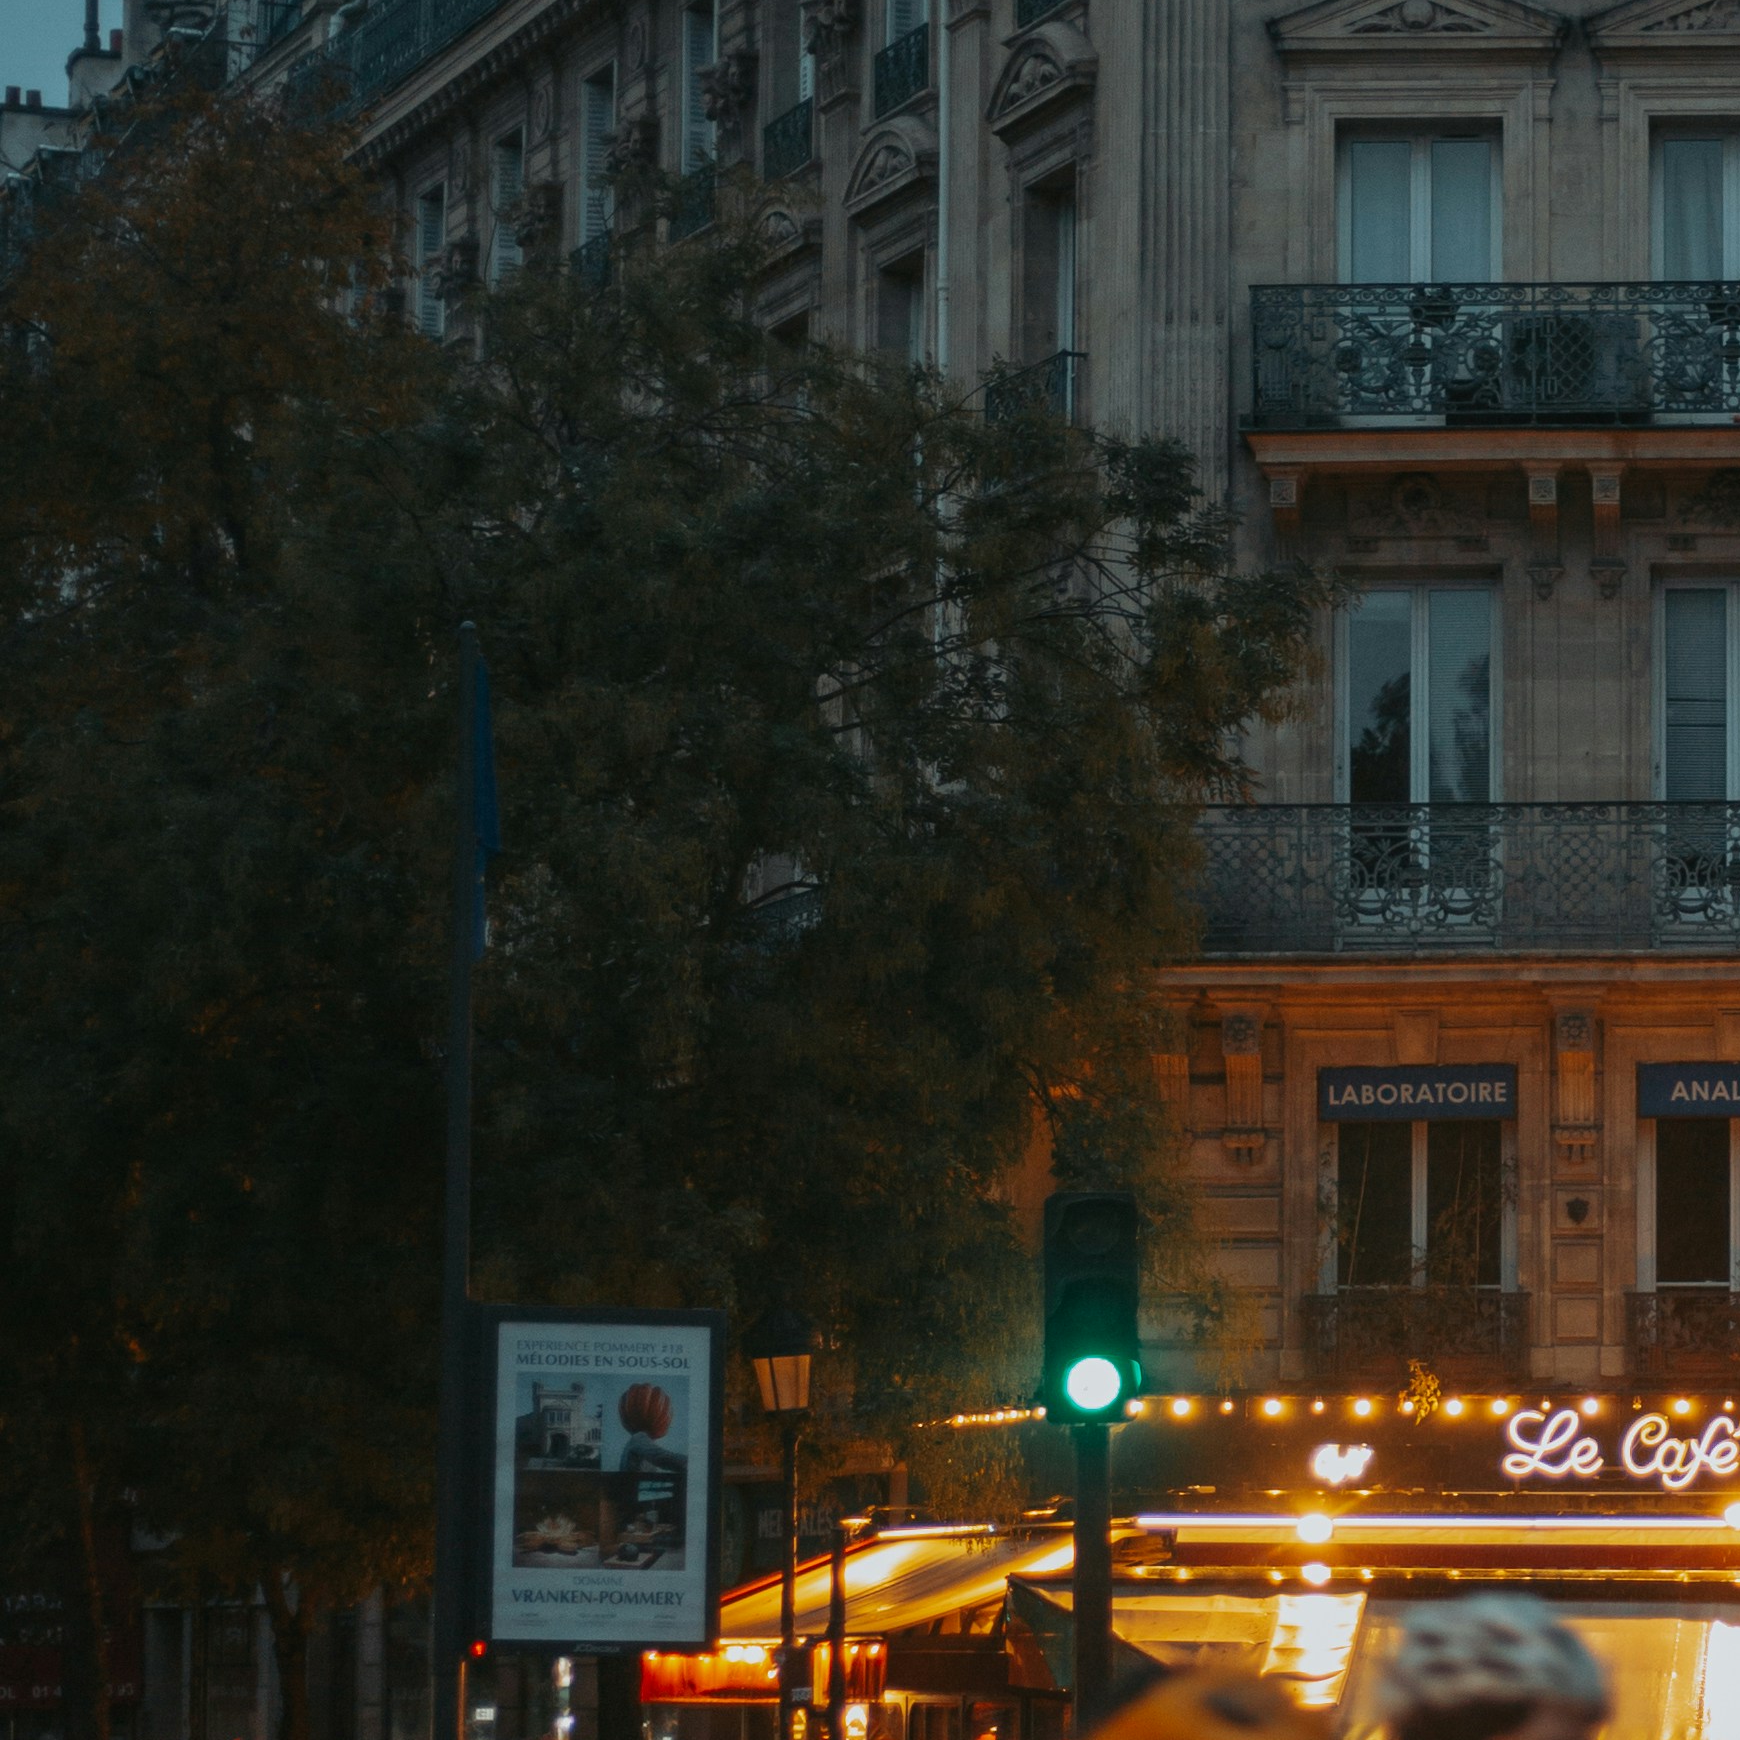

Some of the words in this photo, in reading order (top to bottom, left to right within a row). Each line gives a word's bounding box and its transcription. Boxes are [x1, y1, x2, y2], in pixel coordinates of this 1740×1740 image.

[1328, 1081, 1507, 1106] LABORATOIRE
[594, 1341, 655, 1354] POMMERY
[516, 1352, 590, 1366] MÉLODIES
[594, 1355, 613, 1367] EN
[618, 1356, 690, 1370] SOUS-SOL
[1503, 1410, 1604, 1476] Le
[573, 1576, 623, 1586] DOMAINE
[511, 1589, 685, 1606] VRANKEN-POMMERY
